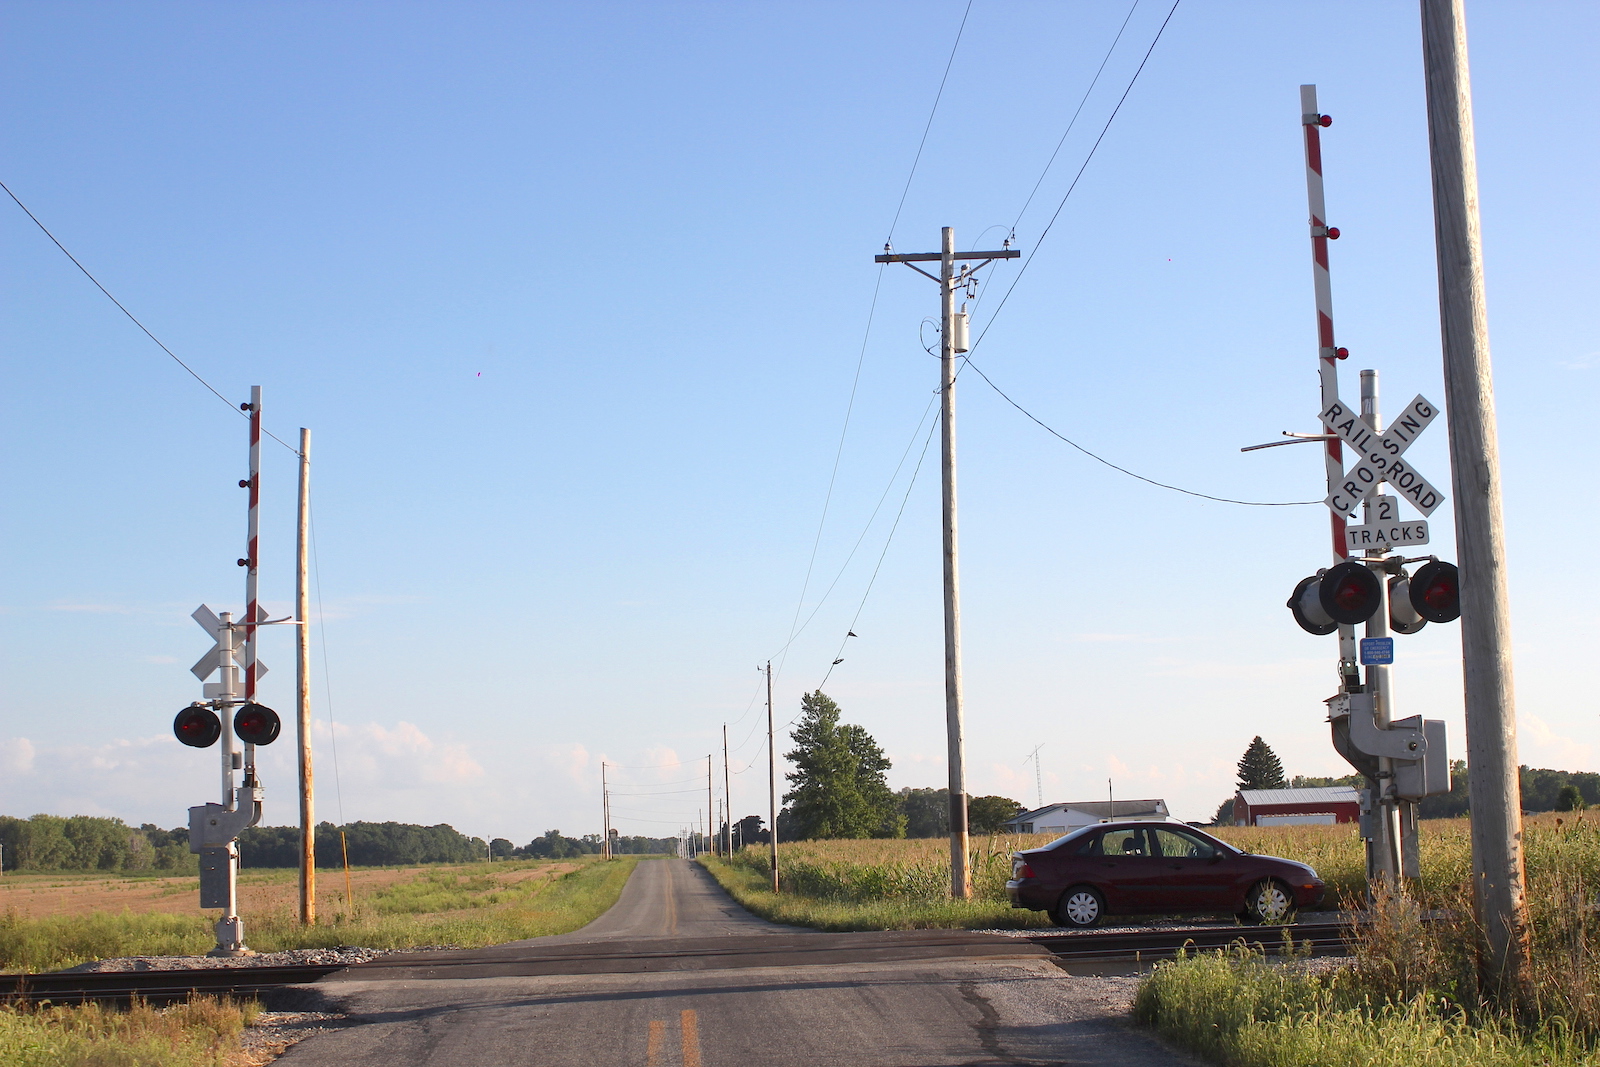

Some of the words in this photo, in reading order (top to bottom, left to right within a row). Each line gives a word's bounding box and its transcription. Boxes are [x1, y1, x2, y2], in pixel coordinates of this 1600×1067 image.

[1324, 403, 1371, 453] RAIL
[1386, 460, 1436, 509] ROAD
[1332, 402, 1432, 511] CROSSING
[1349, 525, 1425, 545] TRACKS
[1379, 501, 1392, 520] 2
